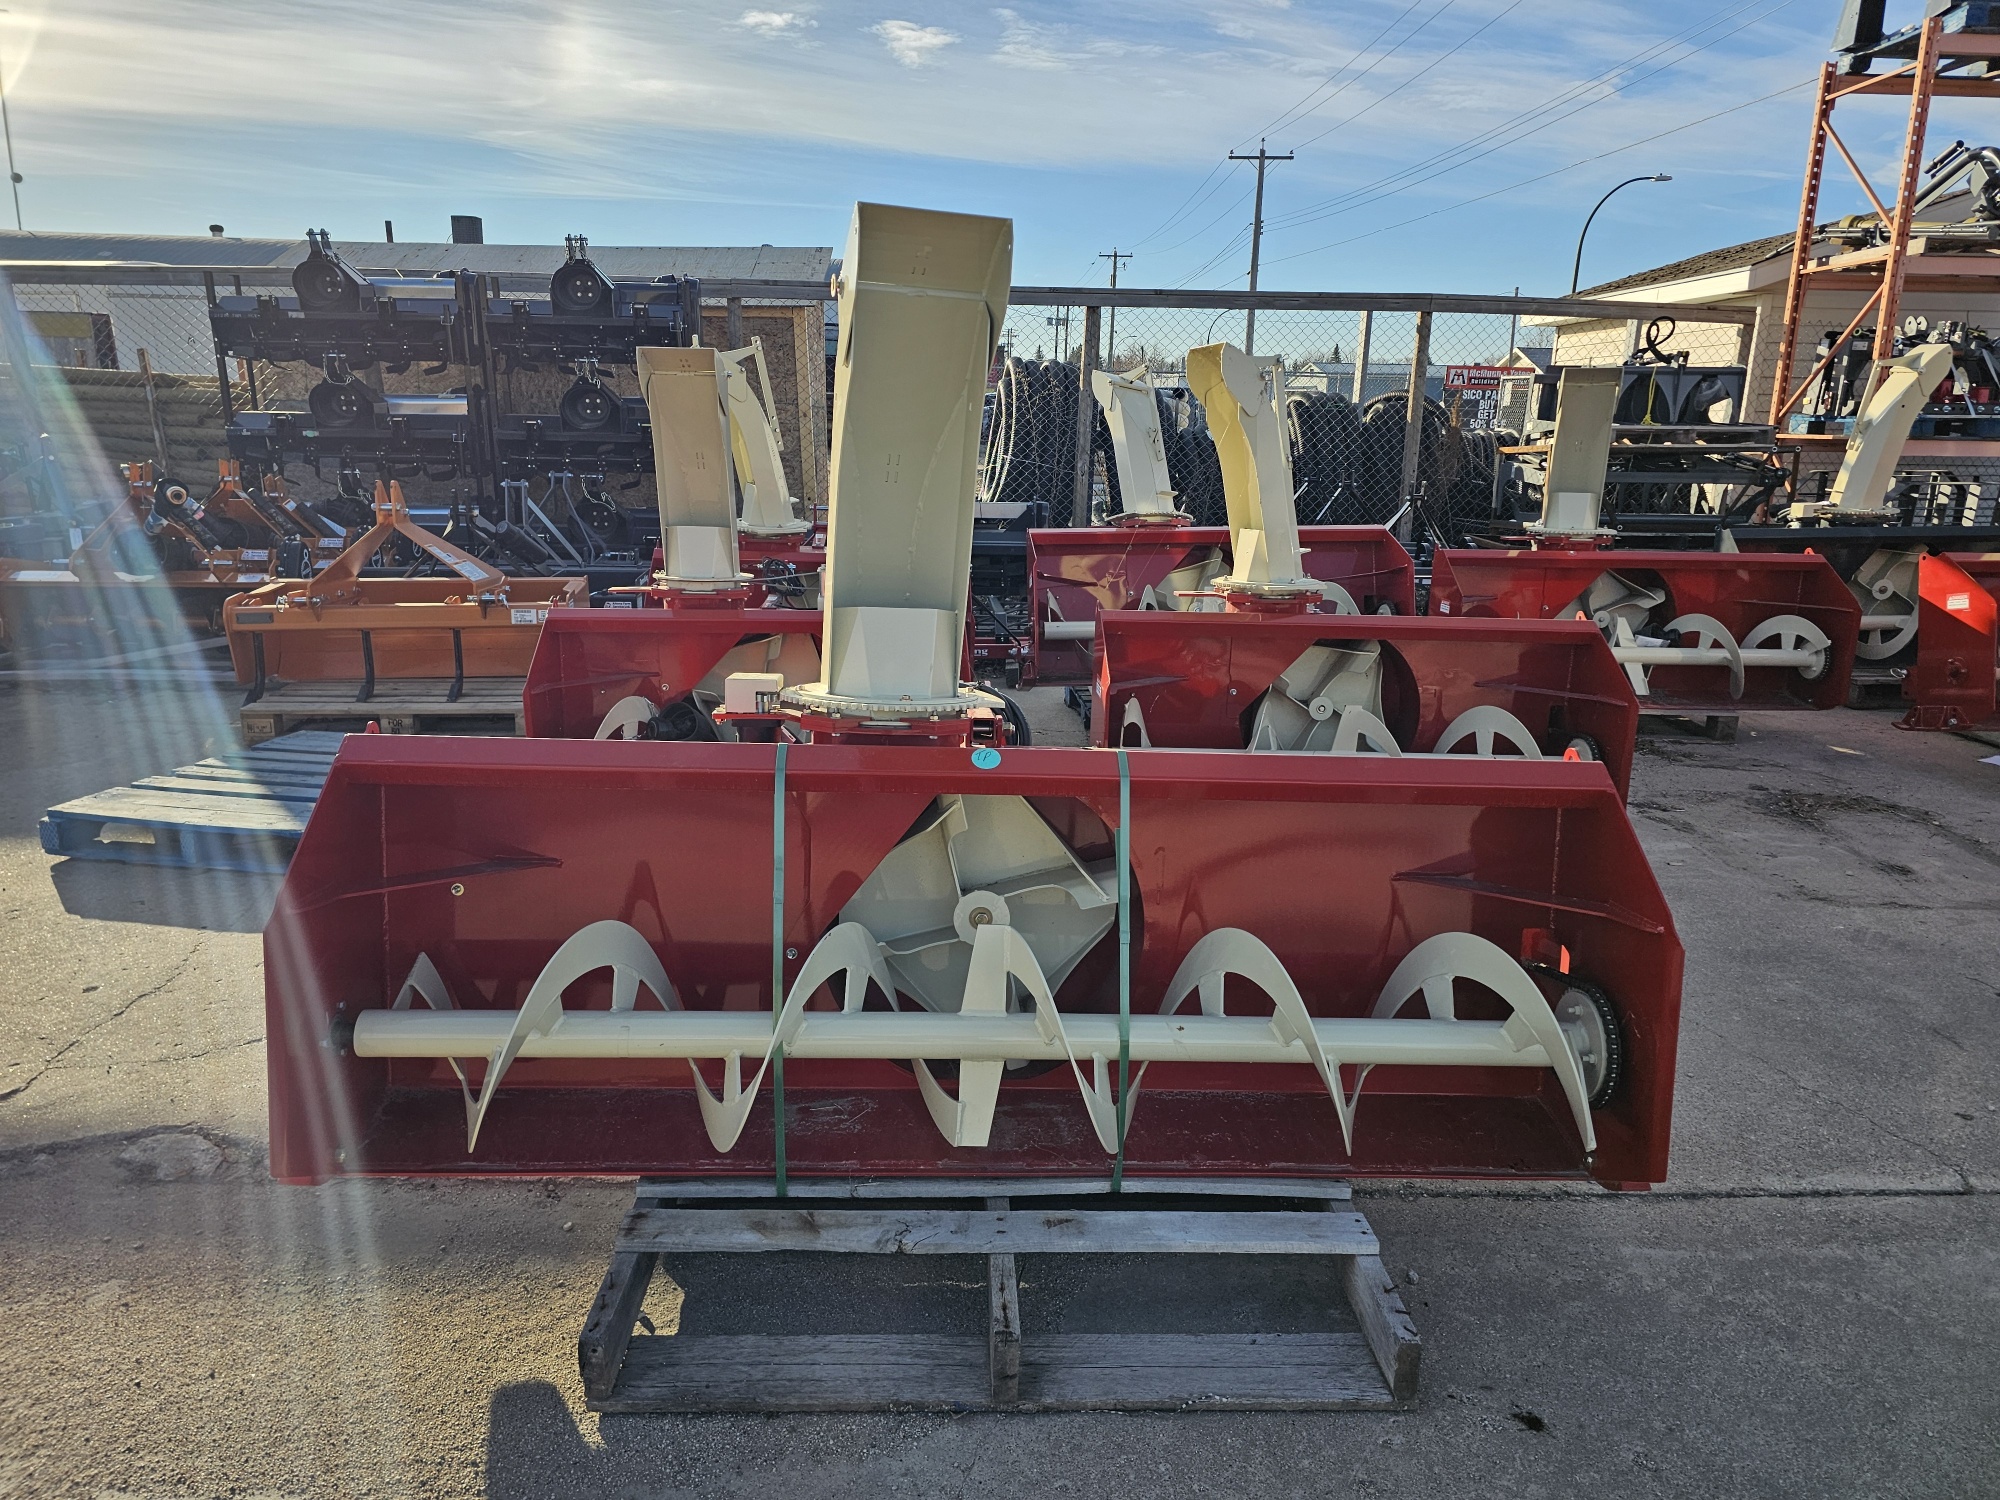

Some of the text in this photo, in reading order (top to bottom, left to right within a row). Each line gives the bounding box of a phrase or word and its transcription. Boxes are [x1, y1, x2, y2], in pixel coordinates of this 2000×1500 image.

[1462, 390, 1497, 400] SICO PA
[1479, 400, 1495, 410] BUY
[1477, 410, 1495, 420] GET
[1469, 419, 1487, 429] 50%
